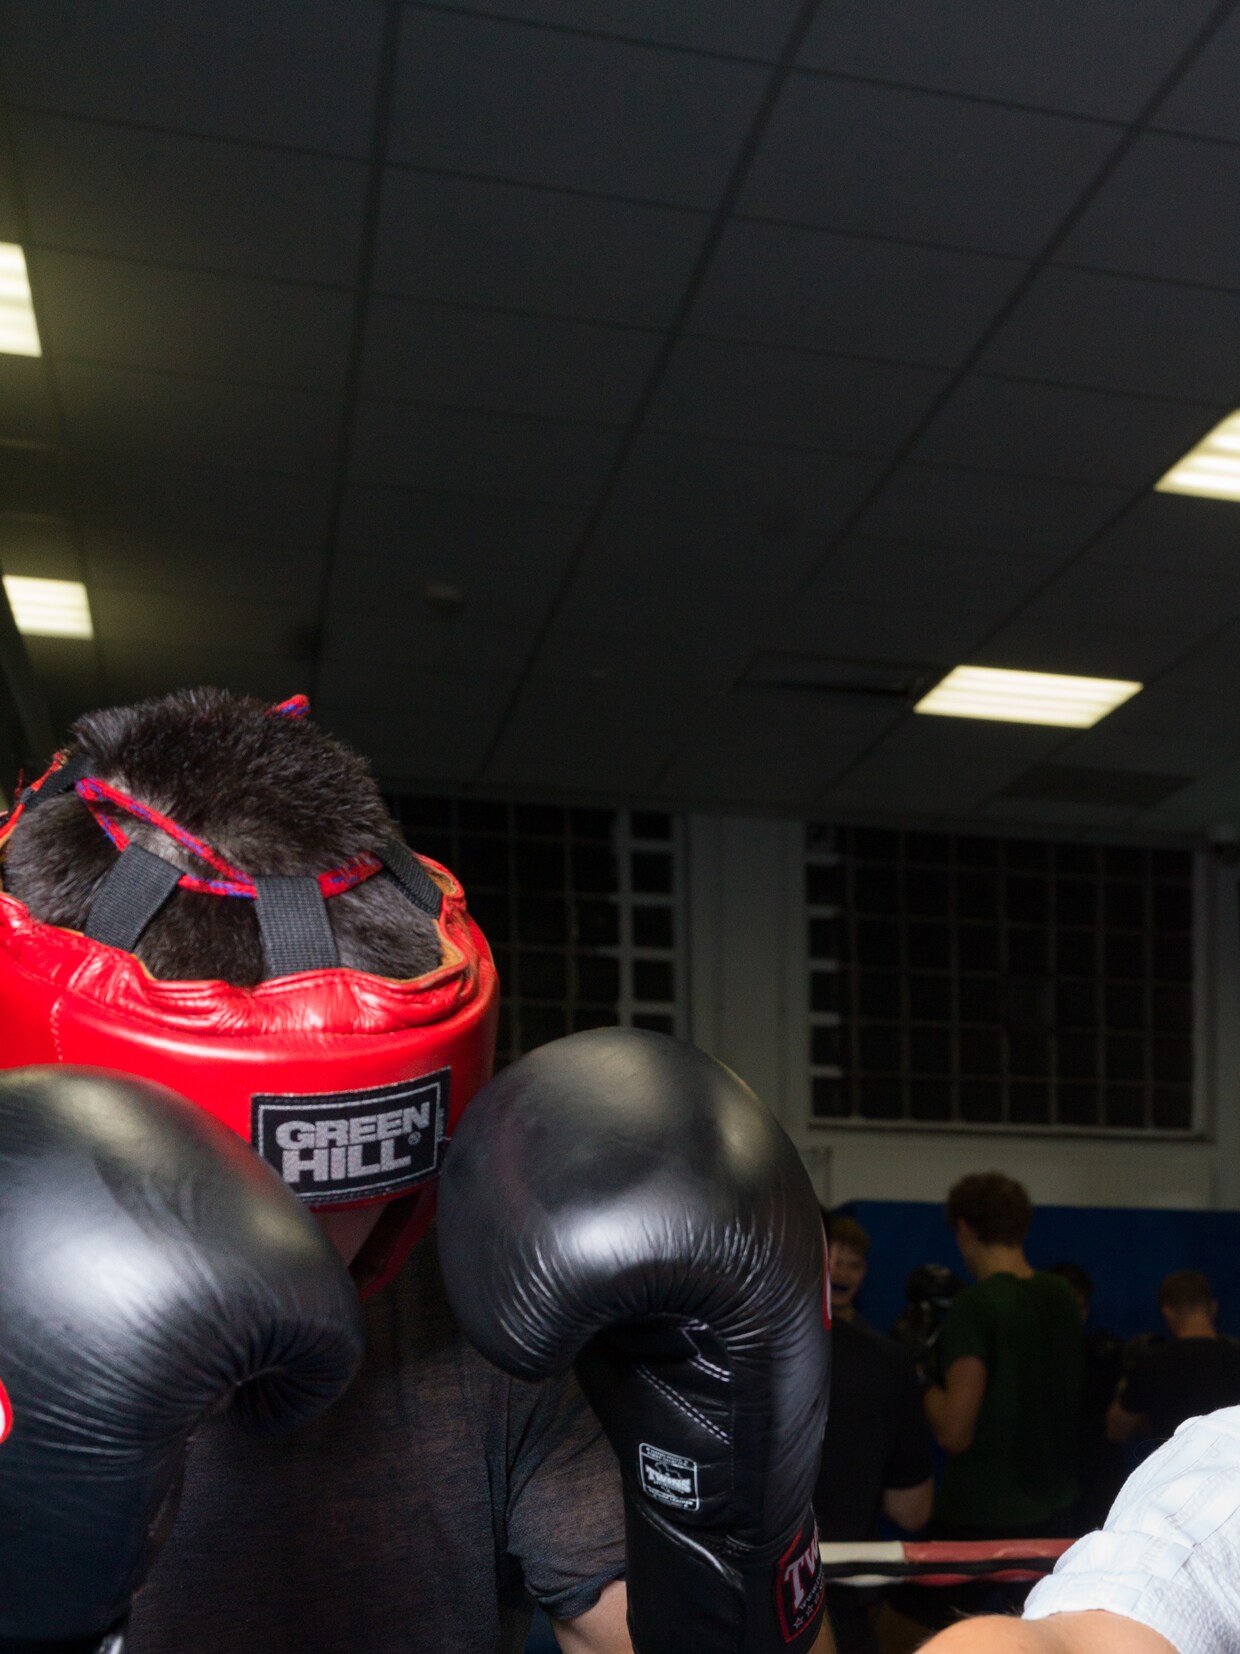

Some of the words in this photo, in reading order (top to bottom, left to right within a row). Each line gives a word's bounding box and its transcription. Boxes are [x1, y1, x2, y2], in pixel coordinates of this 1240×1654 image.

[275, 1102, 430, 1150] GREEN
[281, 1138, 411, 1184] HILL
[645, 1464, 692, 1494] TWINS
